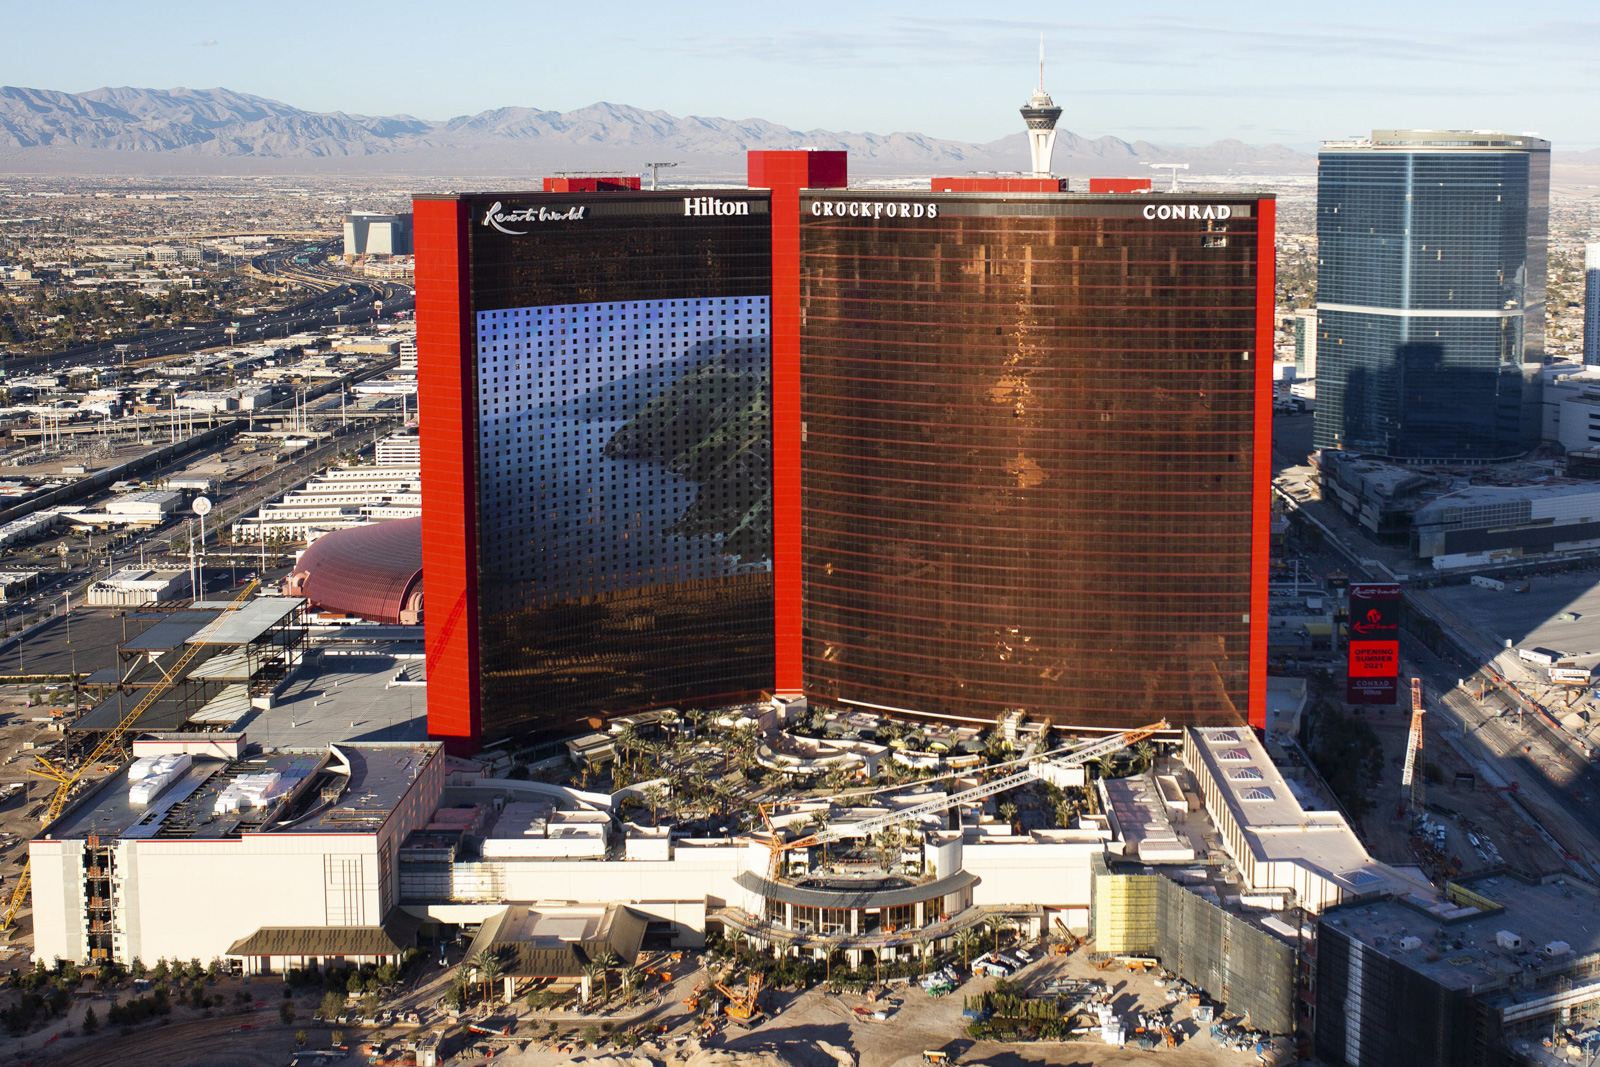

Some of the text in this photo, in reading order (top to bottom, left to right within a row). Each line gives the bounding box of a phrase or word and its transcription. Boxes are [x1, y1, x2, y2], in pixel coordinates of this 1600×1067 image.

[538, 206, 585, 221] World
[683, 196, 749, 216] Hilton
[811, 201, 938, 219] CROCKFORDS
[1142, 204, 1231, 220] CONRAD
[1354, 648, 1394, 656] OPENING
